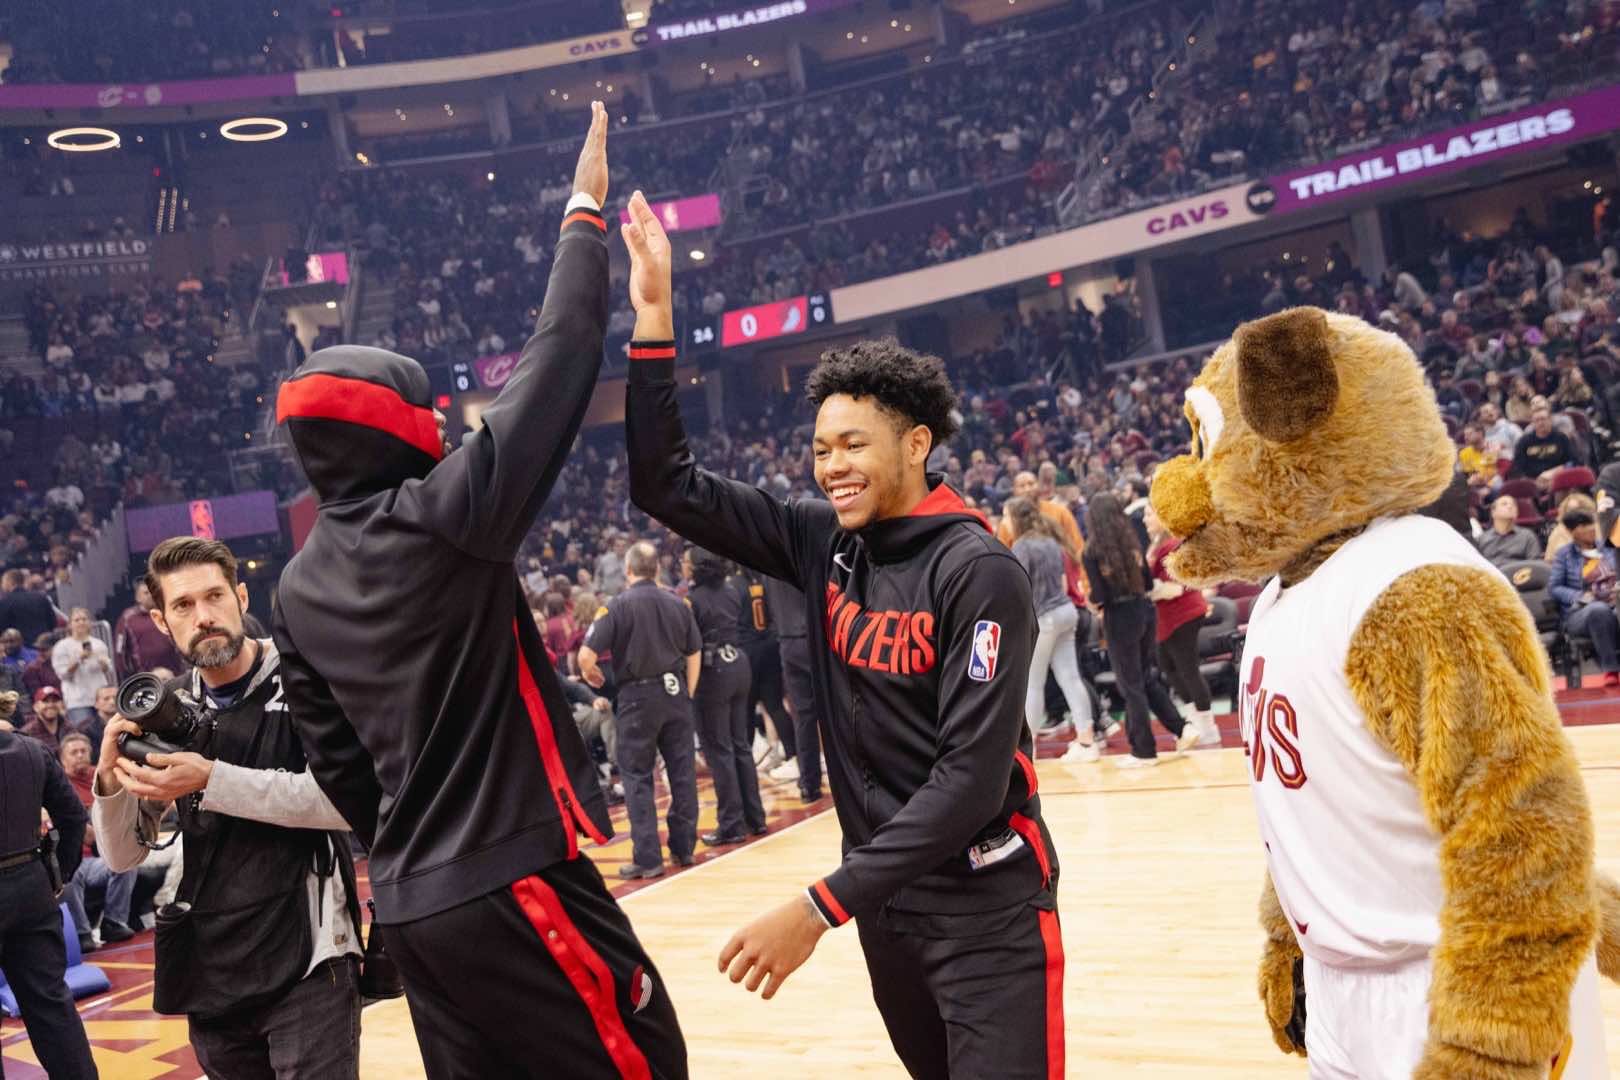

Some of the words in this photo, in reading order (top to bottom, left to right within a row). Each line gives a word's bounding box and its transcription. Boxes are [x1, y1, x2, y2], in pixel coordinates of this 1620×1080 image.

[569, 38, 622, 56] CAVS
[656, 17, 717, 41] TRAIL
[716, 0, 807, 31] BLAZERS
[1146, 200, 1230, 235] CAVS
[1289, 157, 1396, 200] TRAIL
[1395, 108, 1576, 174] BLAZERS
[21, 239, 147, 260] WESTFIELD
[740, 313, 758, 337] 0
[456, 375, 469, 391] 0
[265, 674, 289, 712] 2
